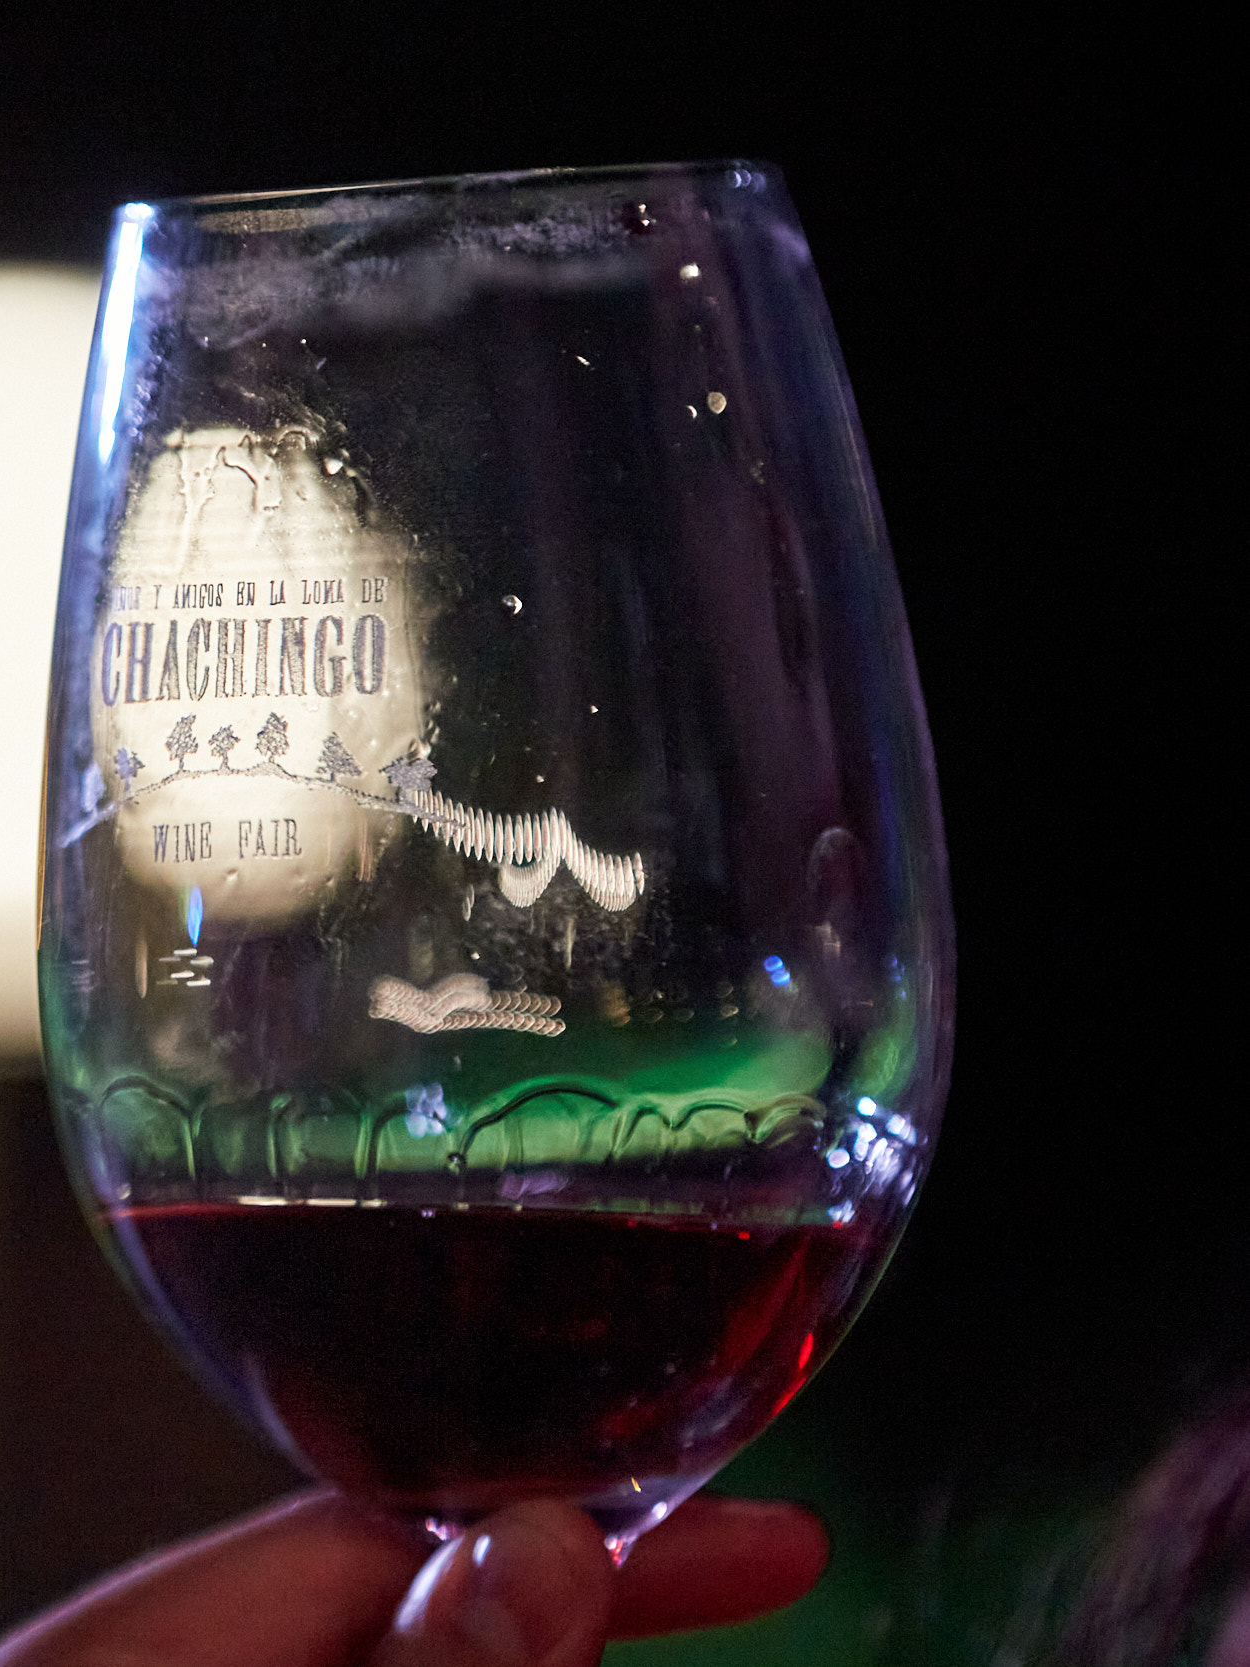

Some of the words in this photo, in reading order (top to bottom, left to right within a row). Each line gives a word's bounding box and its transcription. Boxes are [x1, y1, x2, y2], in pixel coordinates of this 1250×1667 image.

[153, 584, 162, 610] Y
[172, 582, 224, 609] AMIGOS
[236, 580, 256, 606] EN
[269, 579, 286, 606] LA
[301, 578, 345, 605] LOMA
[361, 577, 386, 604] DE
[102, 614, 387, 707] CHACHINGO
[153, 821, 212, 863] WINE
[238, 817, 302, 859] FAIR
